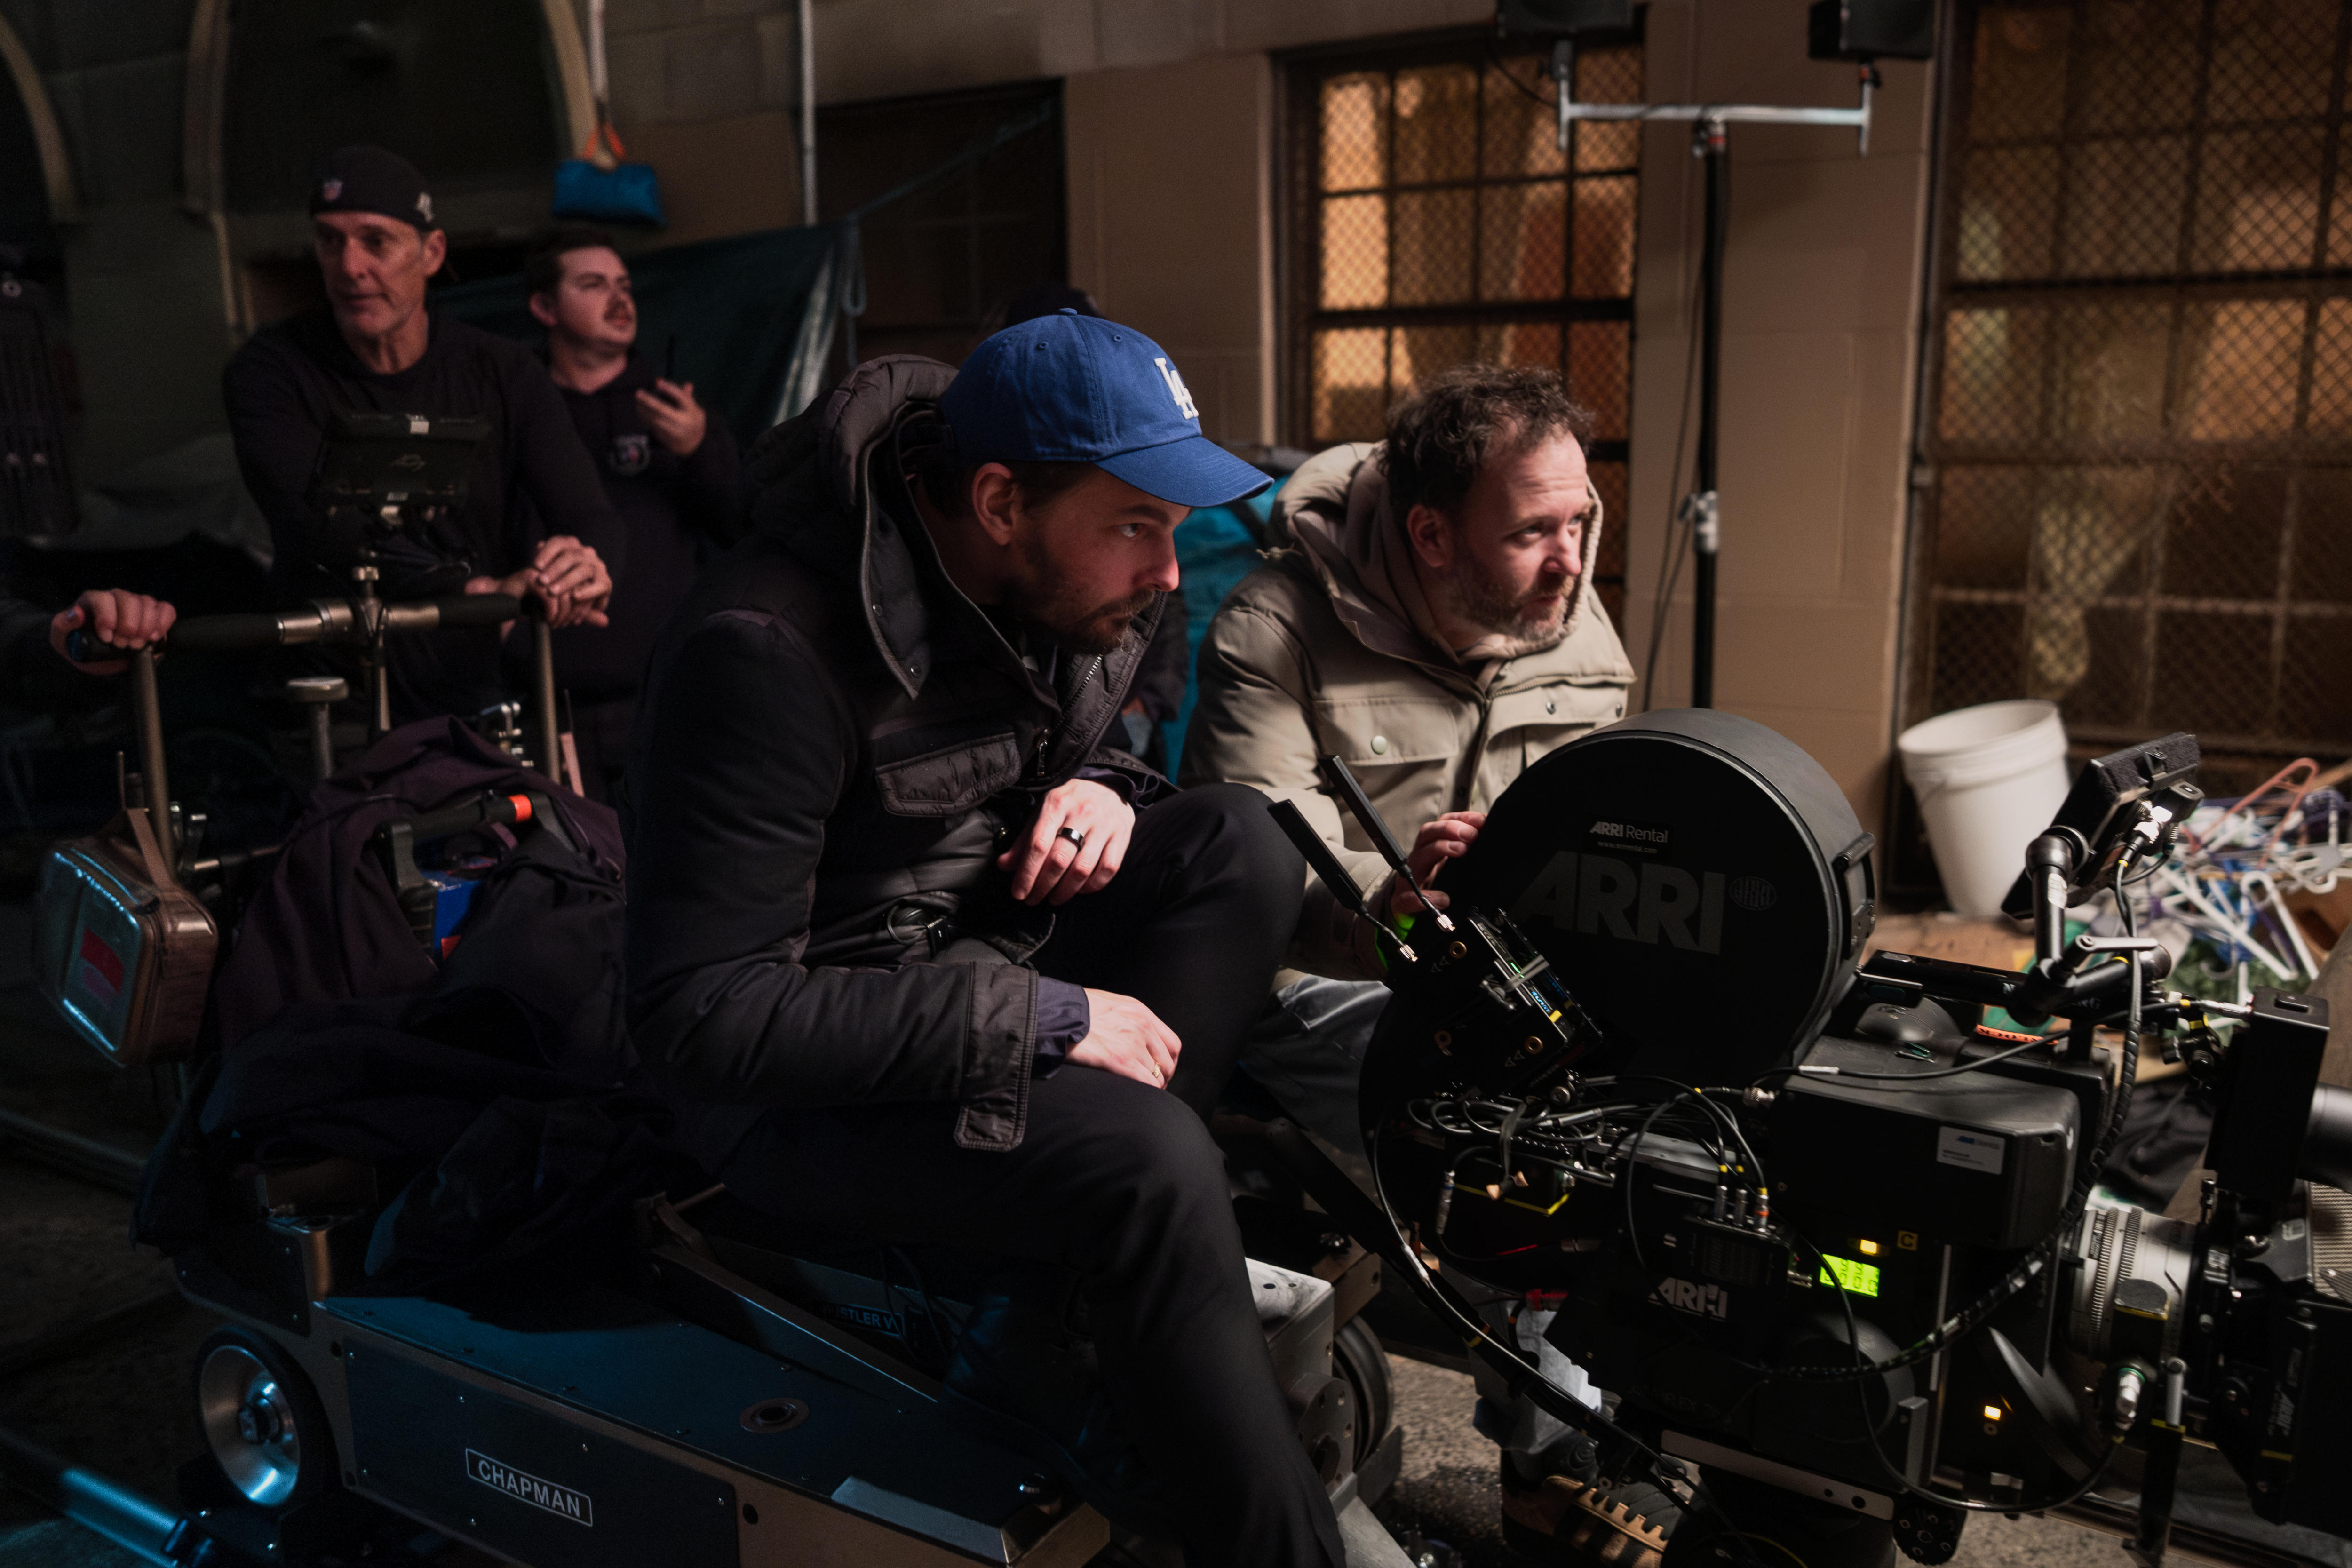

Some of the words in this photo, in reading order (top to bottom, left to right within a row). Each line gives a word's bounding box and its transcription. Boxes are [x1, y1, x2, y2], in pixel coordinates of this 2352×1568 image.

[1154, 357, 1199, 420] LA
[1589, 821, 1624, 838] ARRI
[1626, 825, 1669, 843] Rental
[1506, 850, 1726, 955] ARRI
[1901, 1233, 1914, 1247] C
[478, 1459, 581, 1518] CHAPMAN
